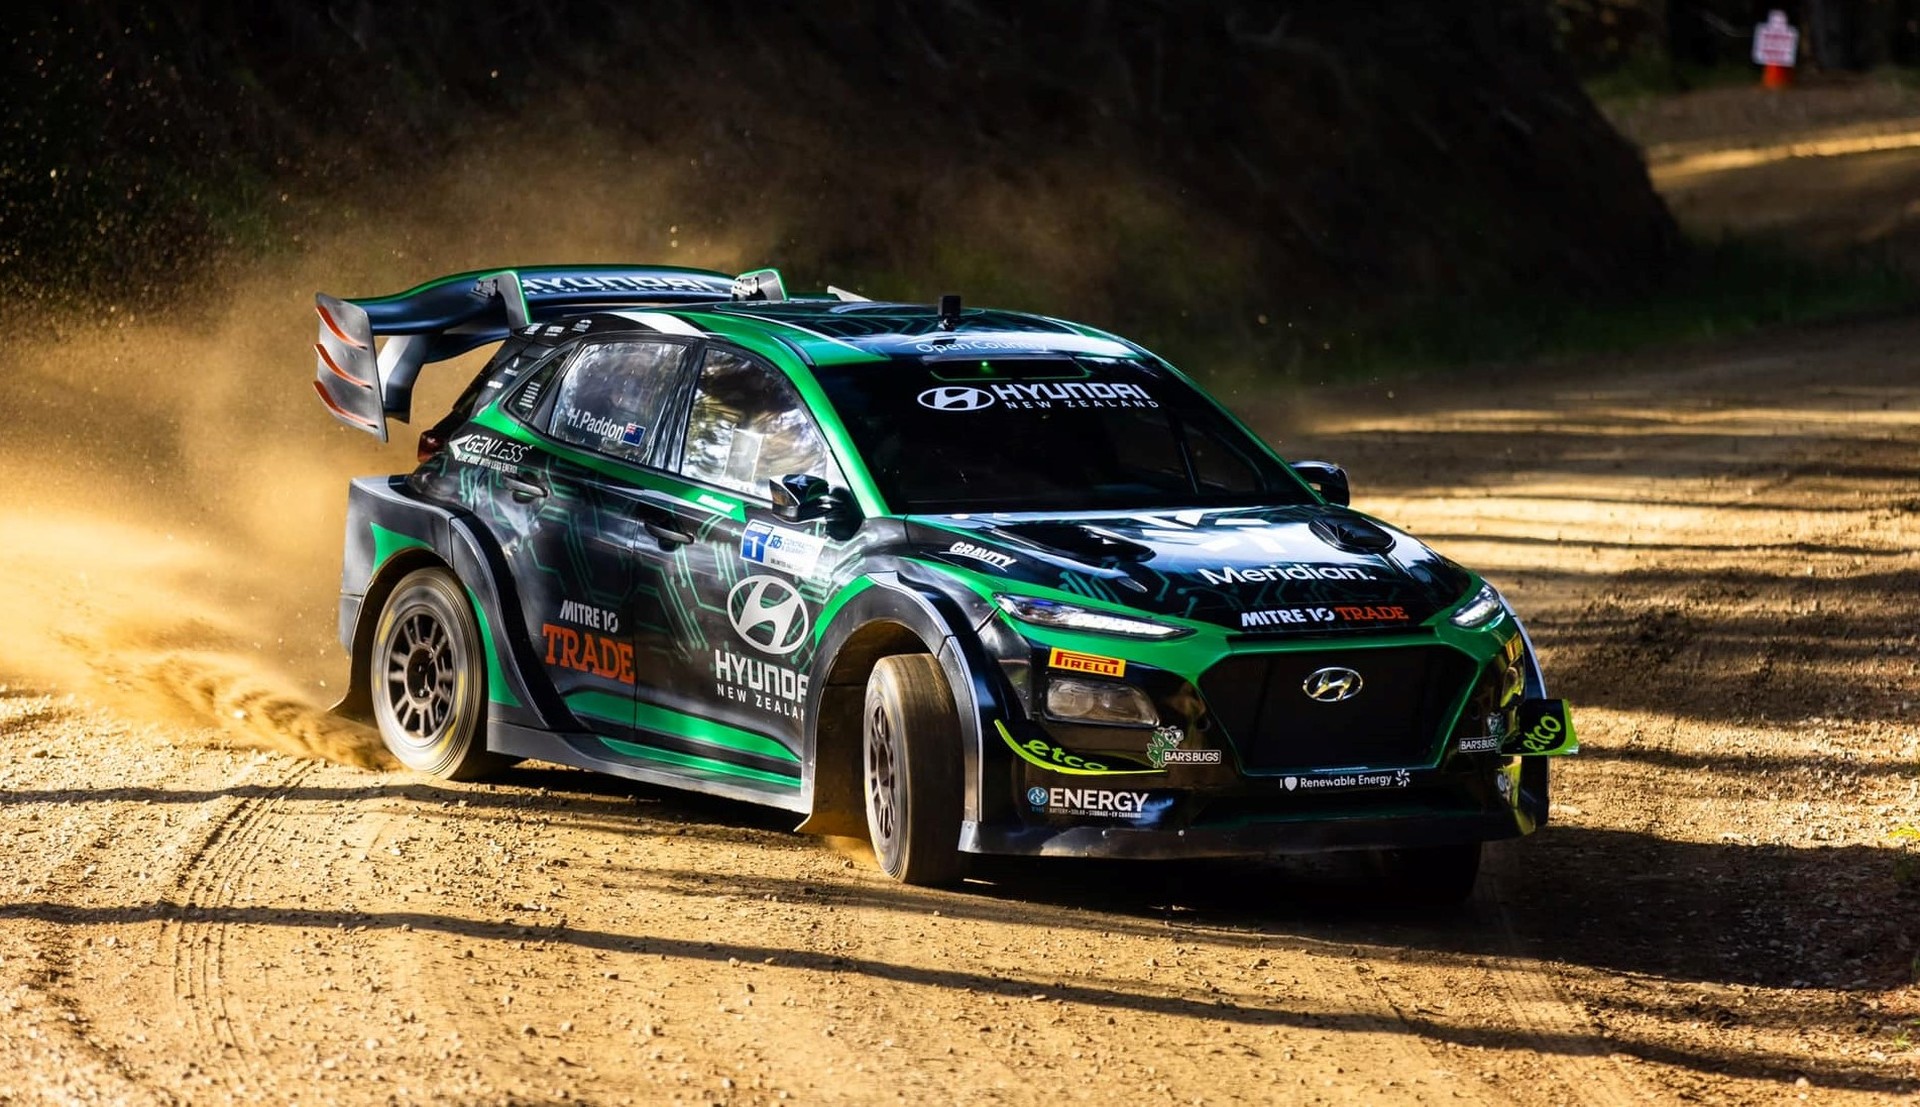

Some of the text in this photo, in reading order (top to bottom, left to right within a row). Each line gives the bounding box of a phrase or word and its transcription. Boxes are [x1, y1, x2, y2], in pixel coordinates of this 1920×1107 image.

[991, 383, 1151, 400] HYUNDAI
[1005, 400, 1159, 409] NEW ZEALAND
[568, 407, 625, 440] H.Paddon
[750, 535, 760, 558] 1
[949, 541, 1018, 567] GRAVITY
[1199, 564, 1377, 585] Meridian.
[560, 599, 619, 634] MITRE 10
[1241, 606, 1409, 627] MITRE 10 TRADE
[543, 623, 635, 685] TRADE
[1055, 651, 1119, 675] PIRELLI
[715, 648, 810, 704] HYUNDA
[717, 682, 805, 722] NEW ZEALA
[1523, 715, 1561, 752] etco
[1023, 739, 1109, 771] etco
[1192, 751, 1219, 762] BUGS
[1300, 777, 1356, 788] Renewable
[1358, 774, 1392, 787] Energy
[1049, 788, 1149, 812] ENERGY
